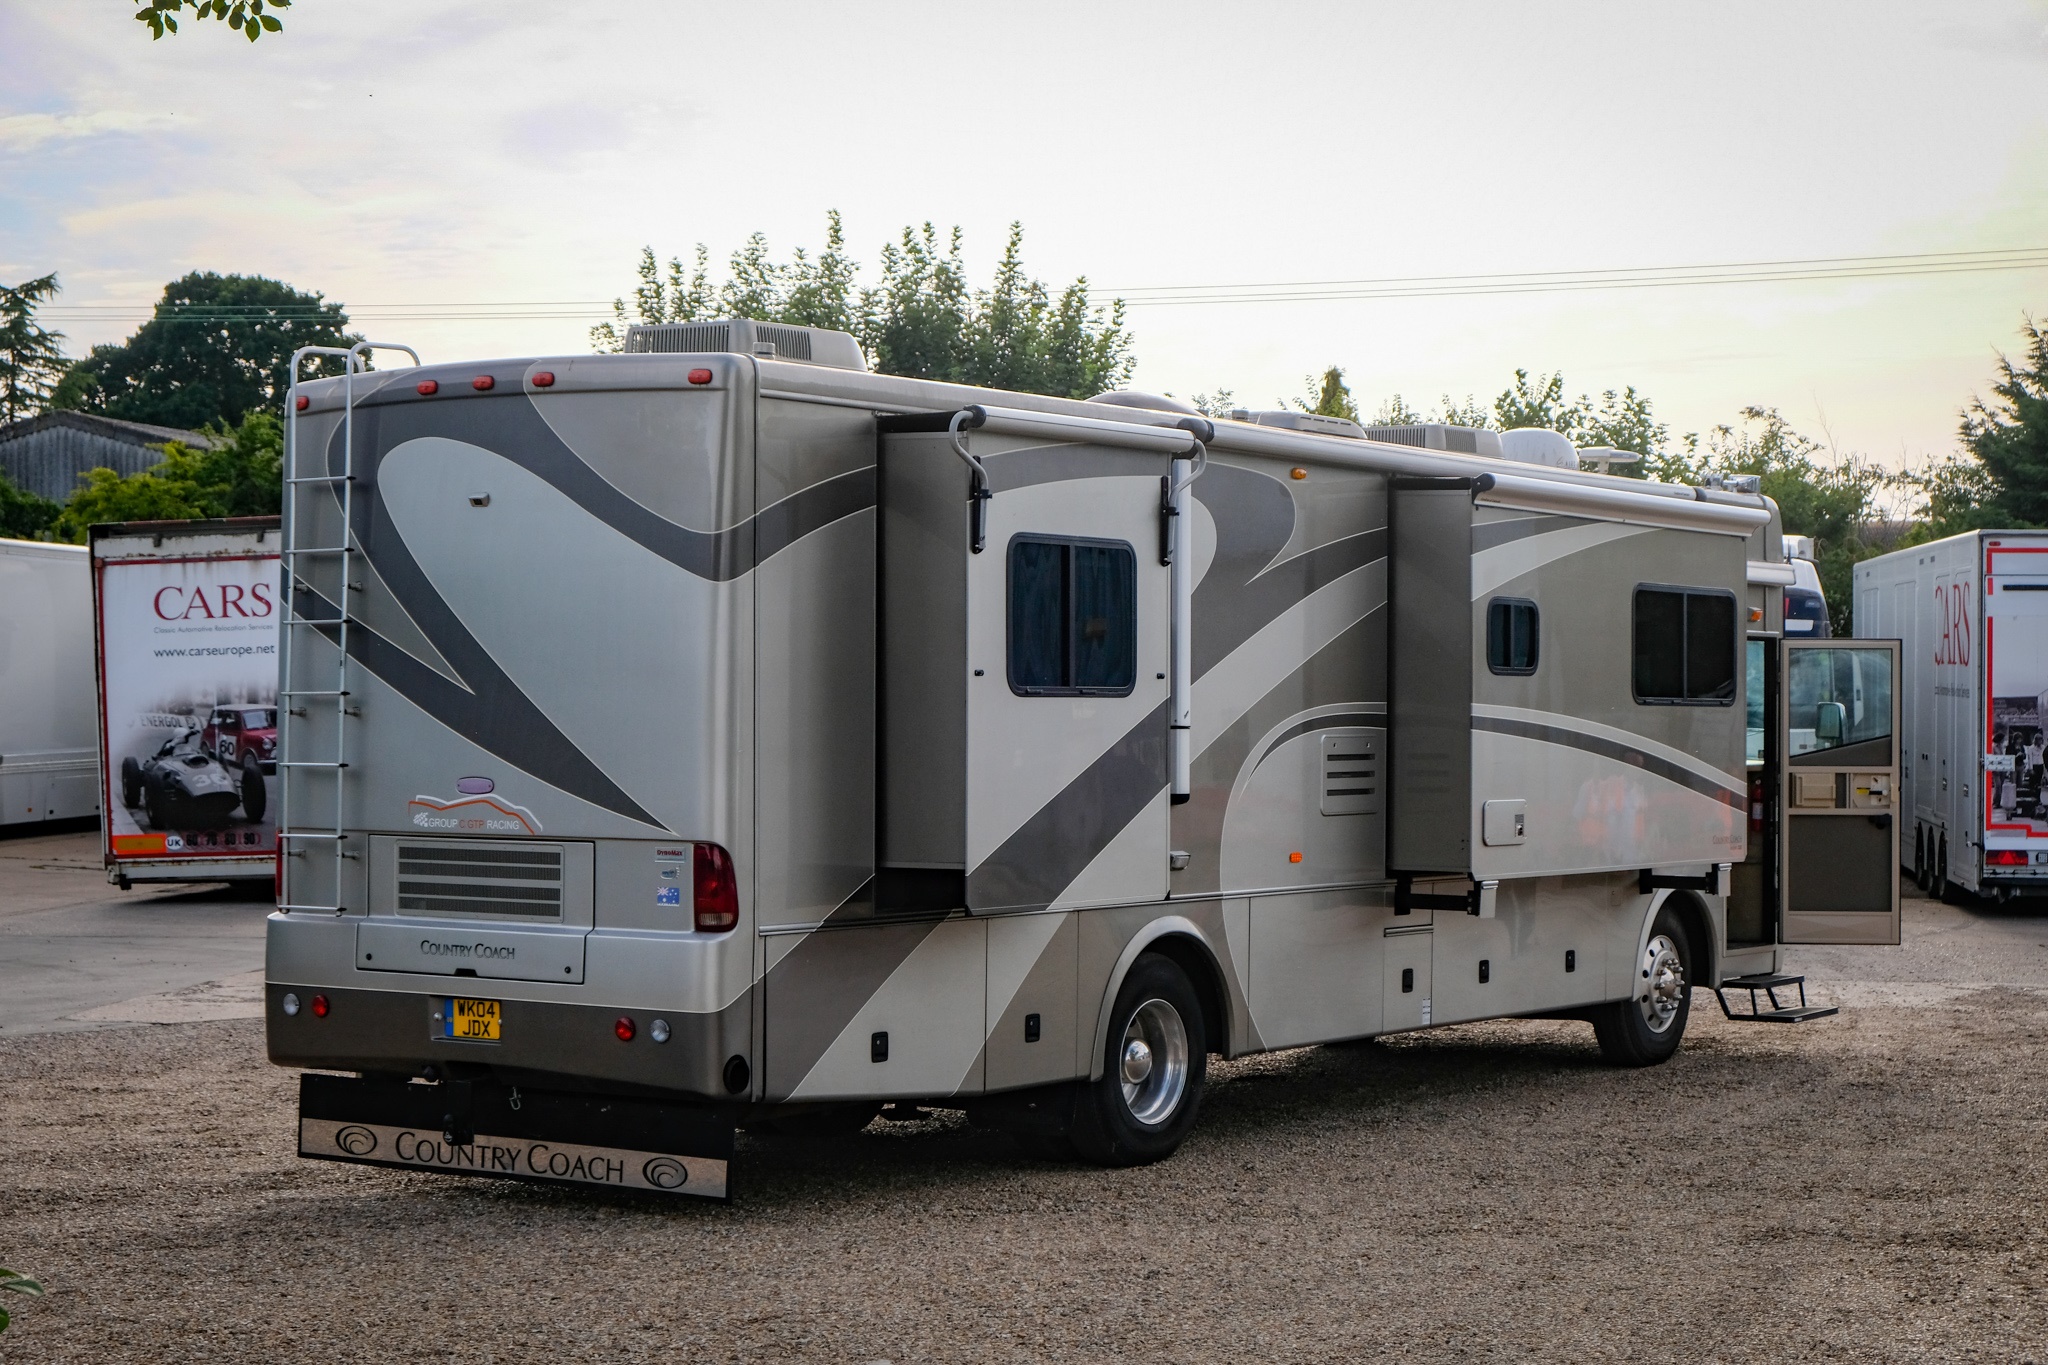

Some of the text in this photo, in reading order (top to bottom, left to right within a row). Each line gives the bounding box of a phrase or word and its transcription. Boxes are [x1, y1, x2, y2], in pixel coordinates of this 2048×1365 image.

[153, 582, 272, 621] CARS
[153, 626, 176, 634] Classic
[178, 625, 213, 633] Automotive
[214, 624, 247, 632] Relocation
[153, 645, 275, 658] www.carseurope.net
[220, 740, 235, 756] 60
[428, 818, 458, 828] GROUP
[486, 820, 519, 830] RACING
[167, 838, 181, 847] UK
[420, 939, 515, 959] COUNTRY COACH
[457, 1000, 495, 1018] WK04
[462, 1019, 490, 1037] JDX
[395, 1131, 624, 1183] COUNTRY COACH
